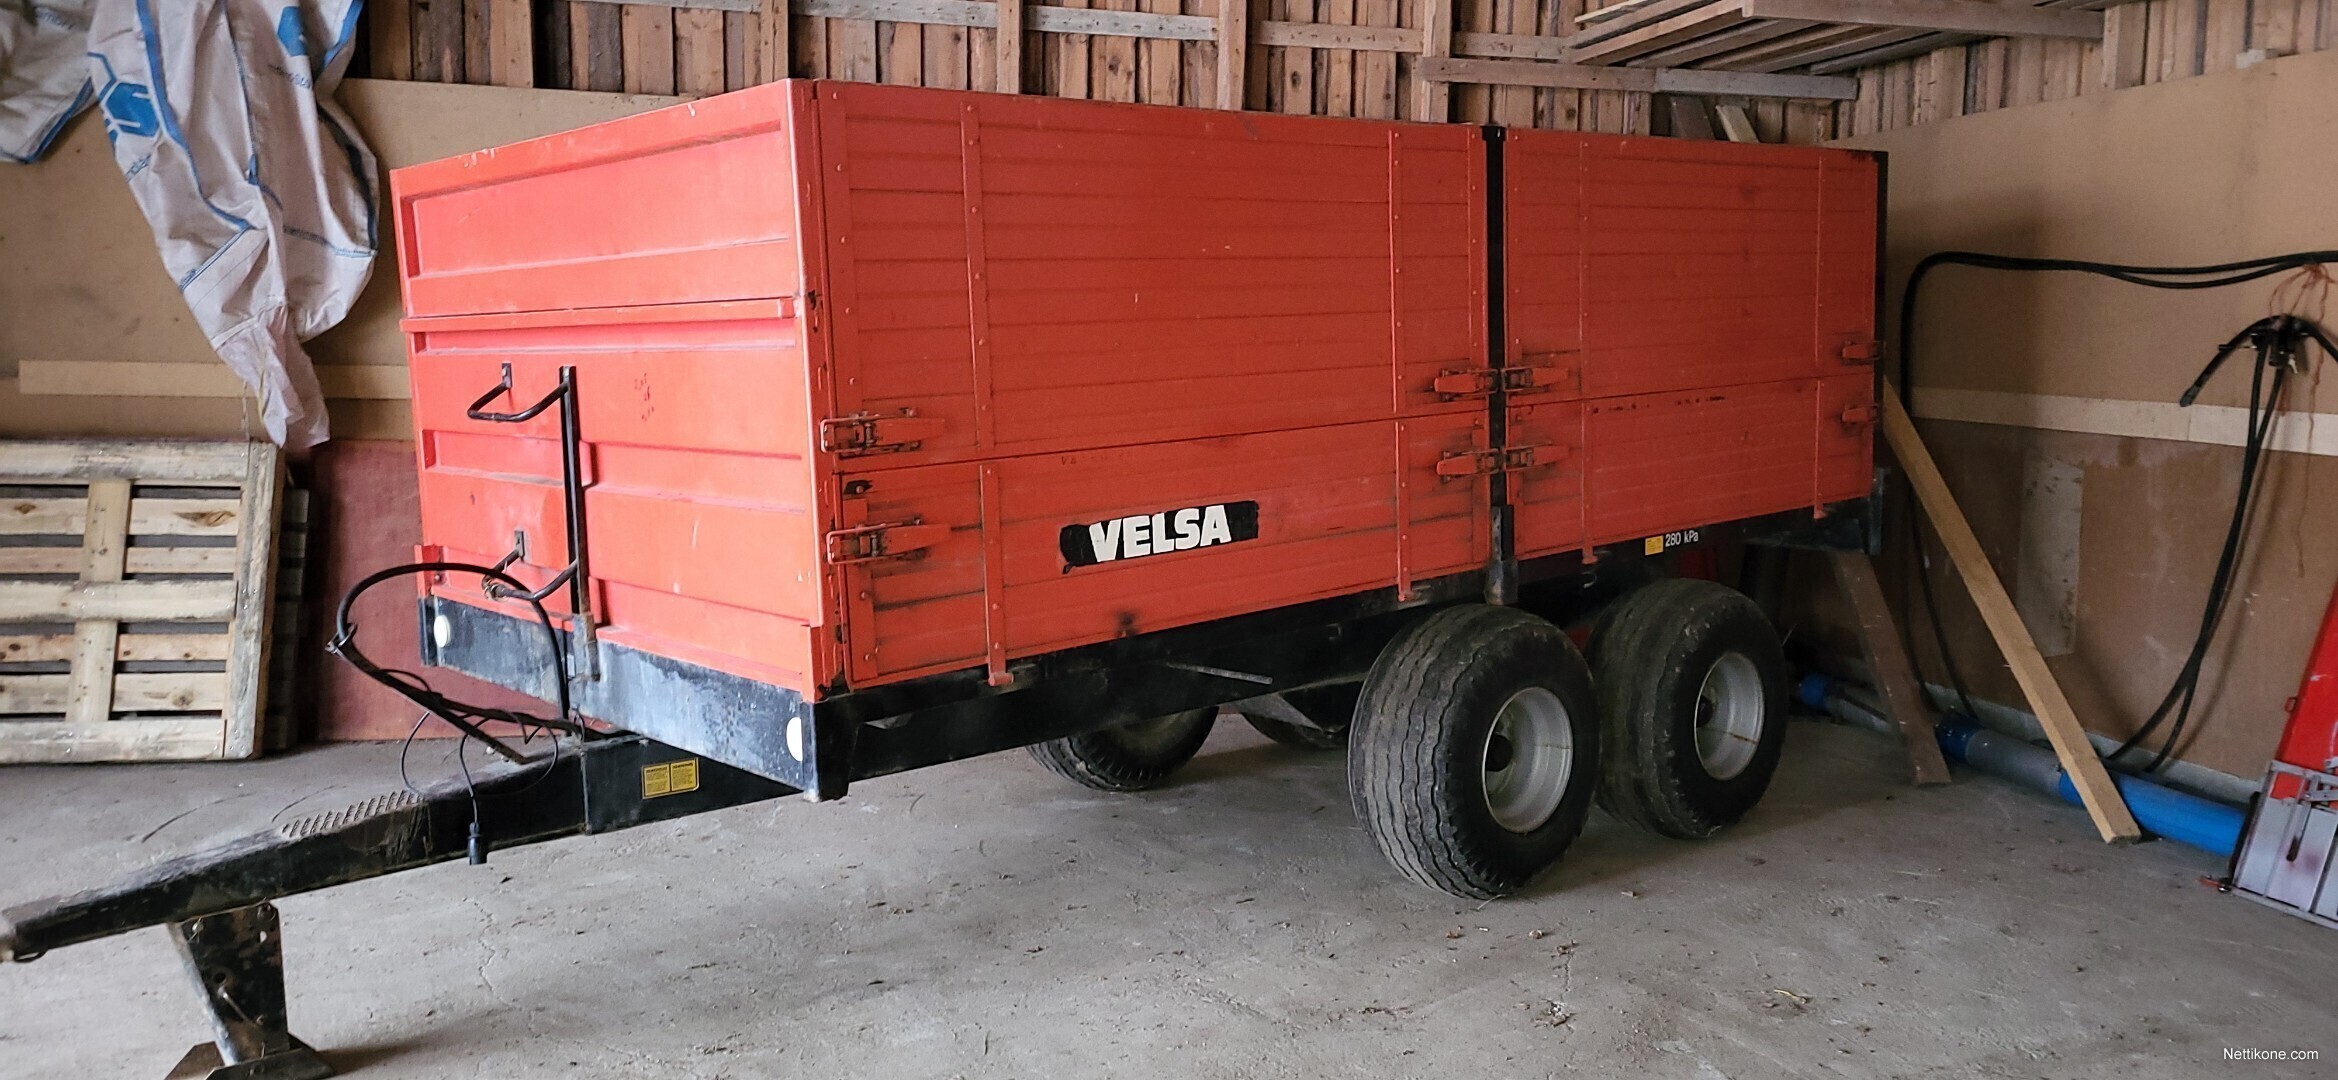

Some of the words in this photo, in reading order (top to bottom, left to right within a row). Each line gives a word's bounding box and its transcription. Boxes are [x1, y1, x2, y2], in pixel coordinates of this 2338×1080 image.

[1088, 504, 1232, 563] VELSA
[1665, 532, 1681, 547] 280
[1684, 529, 1699, 543] kPa
